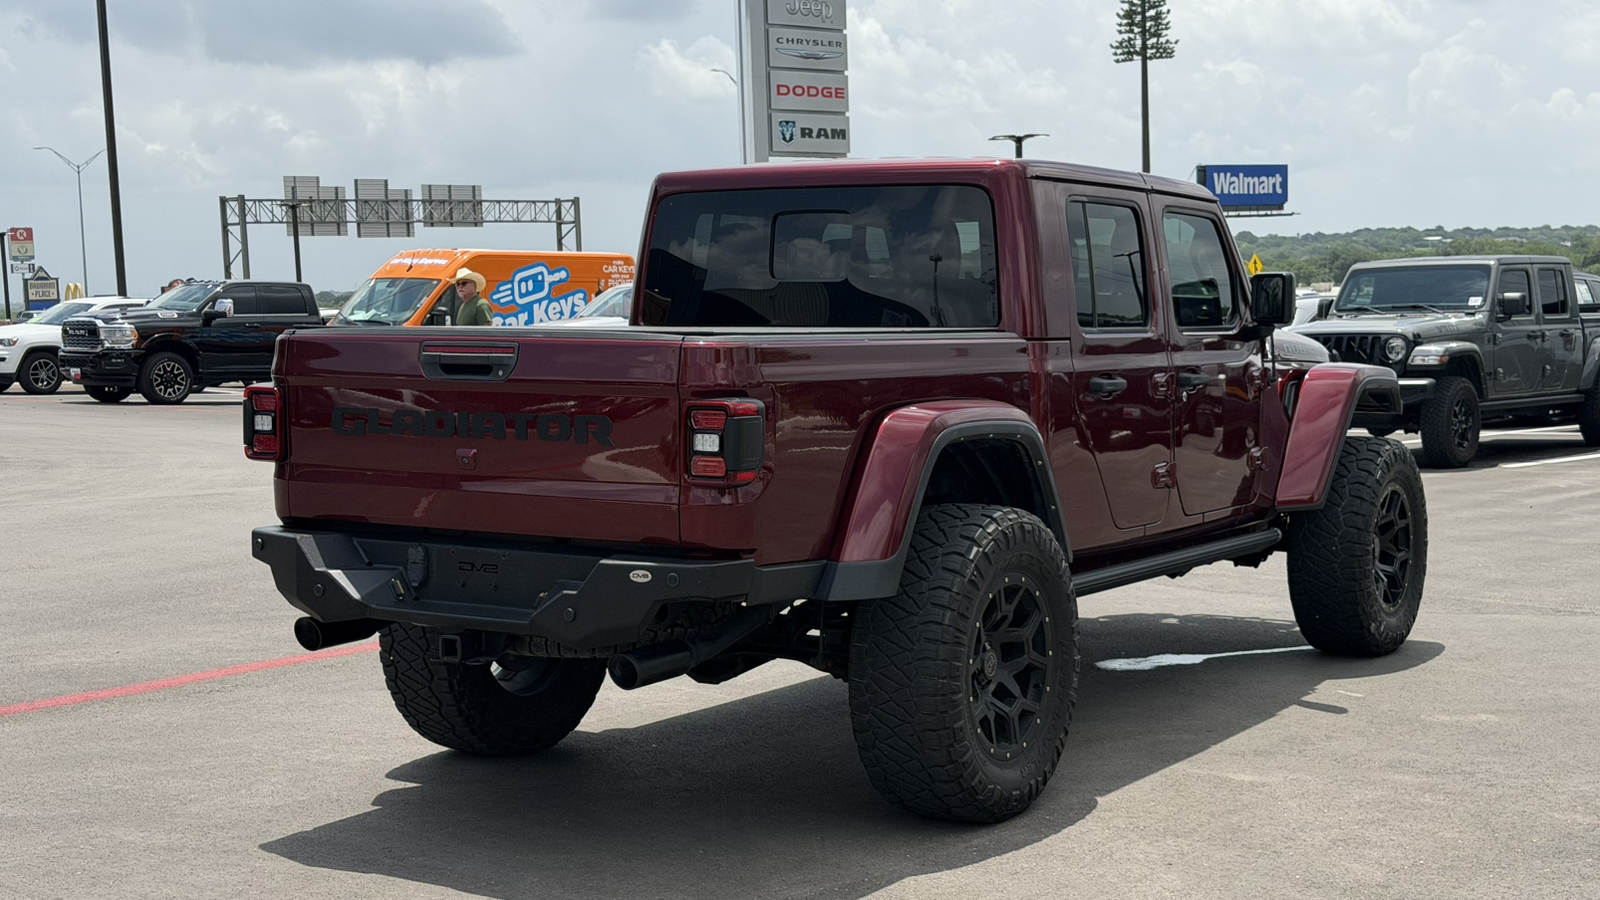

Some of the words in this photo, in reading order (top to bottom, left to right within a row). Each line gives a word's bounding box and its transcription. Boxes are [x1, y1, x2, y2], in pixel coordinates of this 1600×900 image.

[786, 0, 833, 24] Jeep
[776, 37, 843, 48] CHRYSLER
[776, 84, 845, 100] DODGE
[800, 127, 847, 140] RAM
[1213, 172, 1282, 195] Walmart
[602, 265, 618, 273] CAR
[34, 290, 51, 298] PLACE
[533, 292, 585, 325] Keys
[331, 407, 616, 447] GLADIATOR
